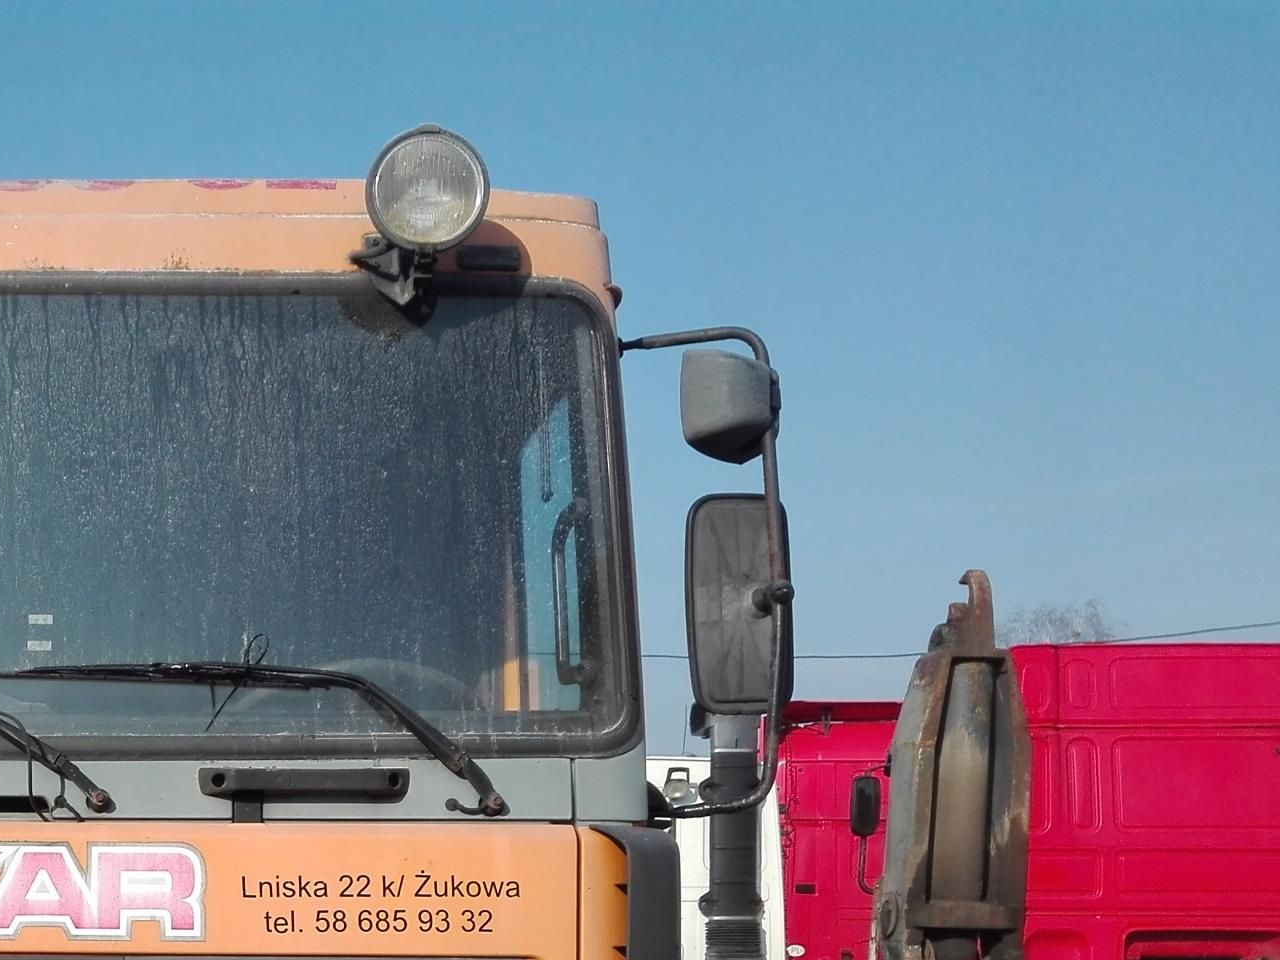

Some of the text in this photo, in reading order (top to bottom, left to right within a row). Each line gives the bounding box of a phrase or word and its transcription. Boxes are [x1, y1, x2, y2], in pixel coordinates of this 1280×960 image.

[241, 869, 521, 898] Lniska 22 k/ Żukowa
[264, 910, 493, 933] tel. 58 685 93 32
